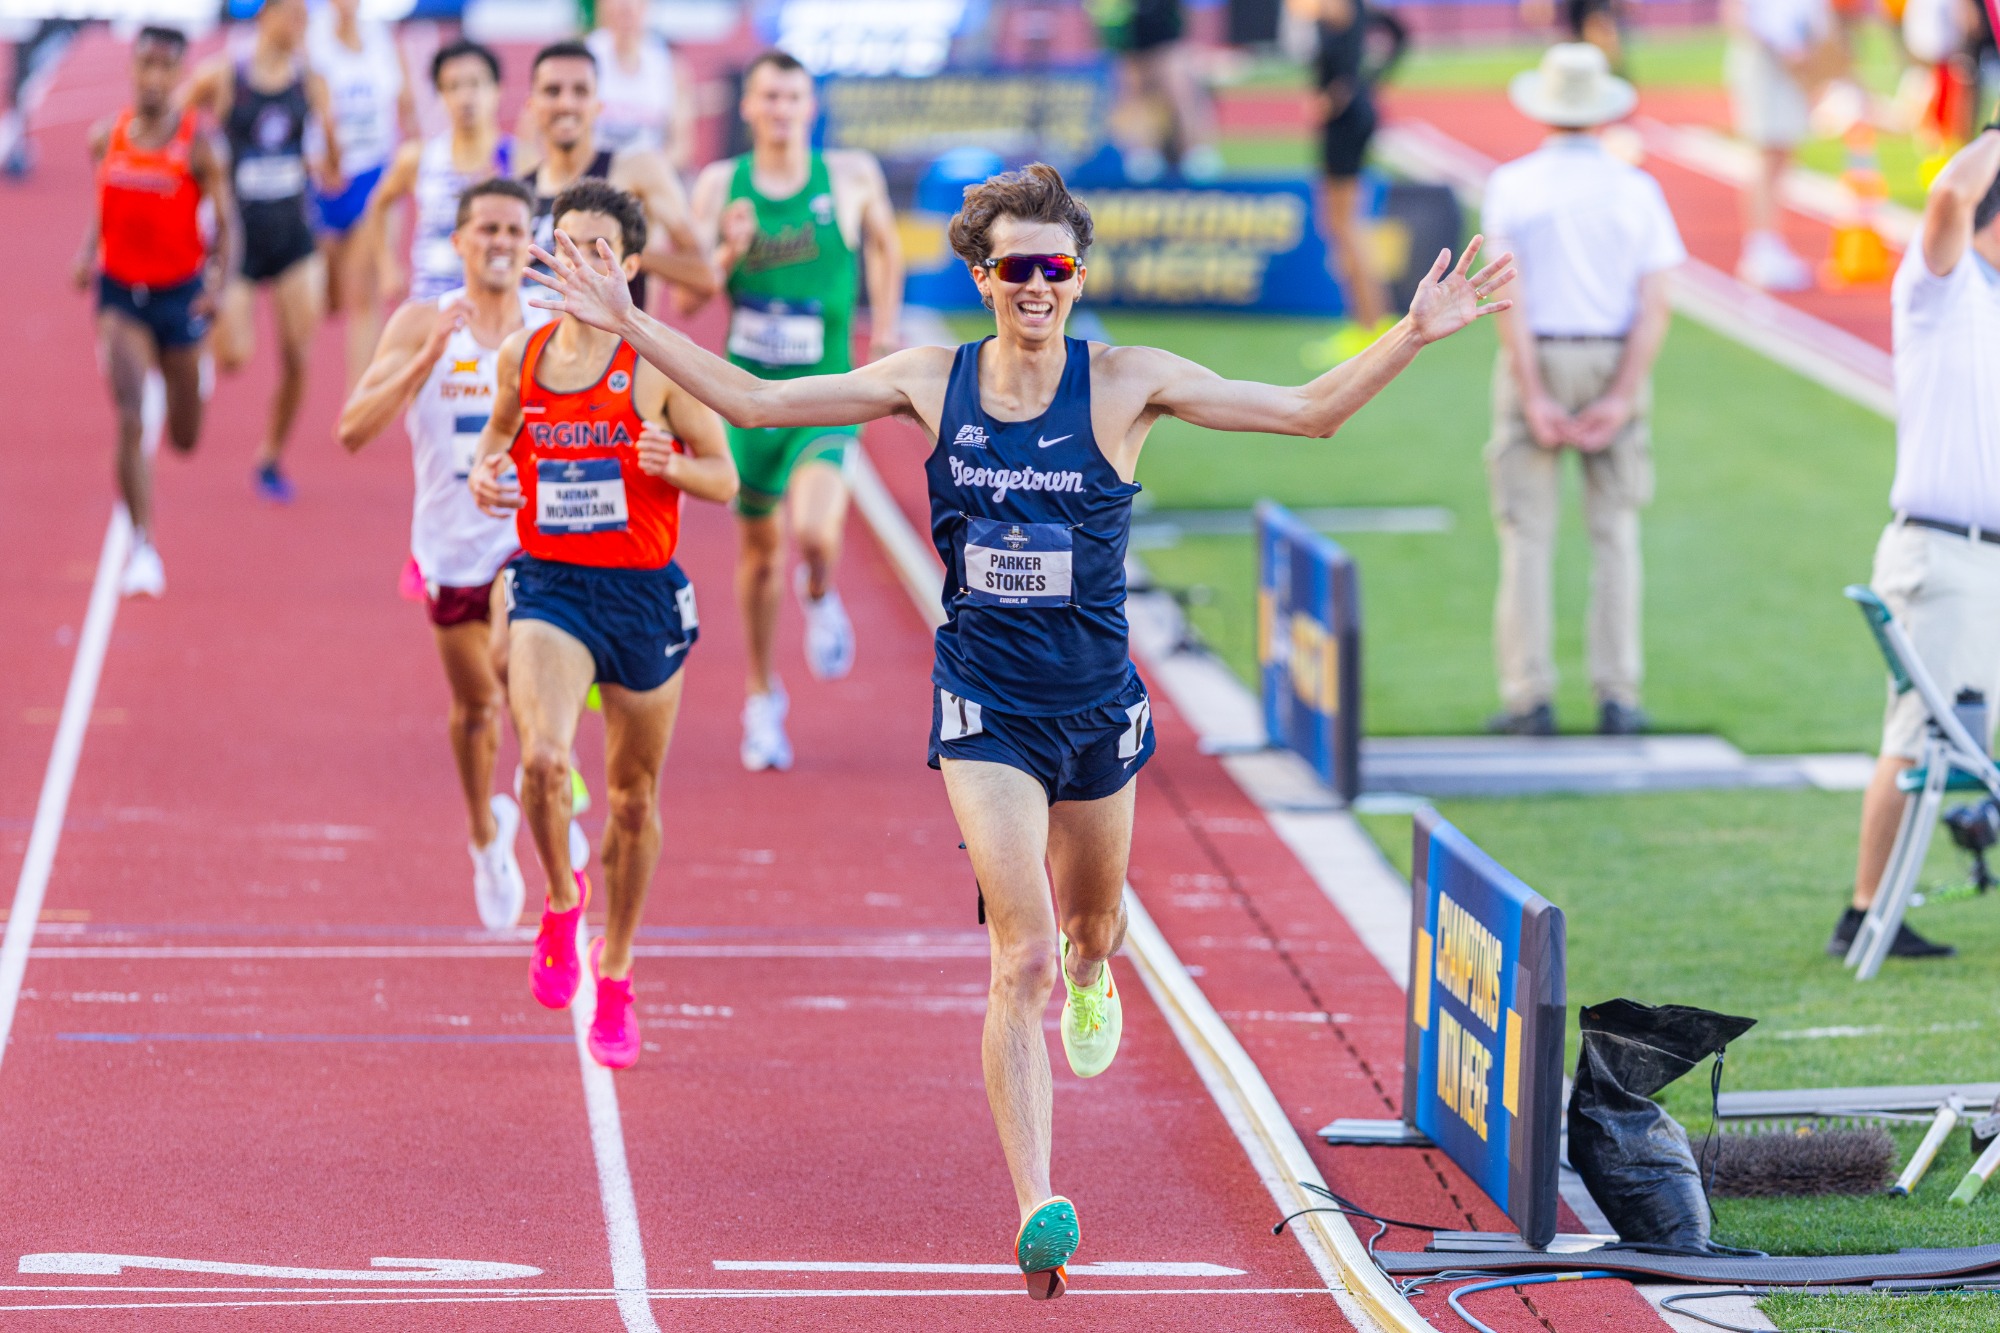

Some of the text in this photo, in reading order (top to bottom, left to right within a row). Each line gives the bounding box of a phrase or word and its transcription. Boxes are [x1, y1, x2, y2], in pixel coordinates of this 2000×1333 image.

[955, 432, 990, 444] EAST
[959, 424, 984, 435] BIG
[545, 503, 616, 518] MOUNTAIN
[990, 553, 1042, 571] PARKER
[985, 571, 1046, 592] STOKES
[1436, 890, 1503, 1034] CHAMPIONS
[1459, 1027, 1494, 1143] HERE
